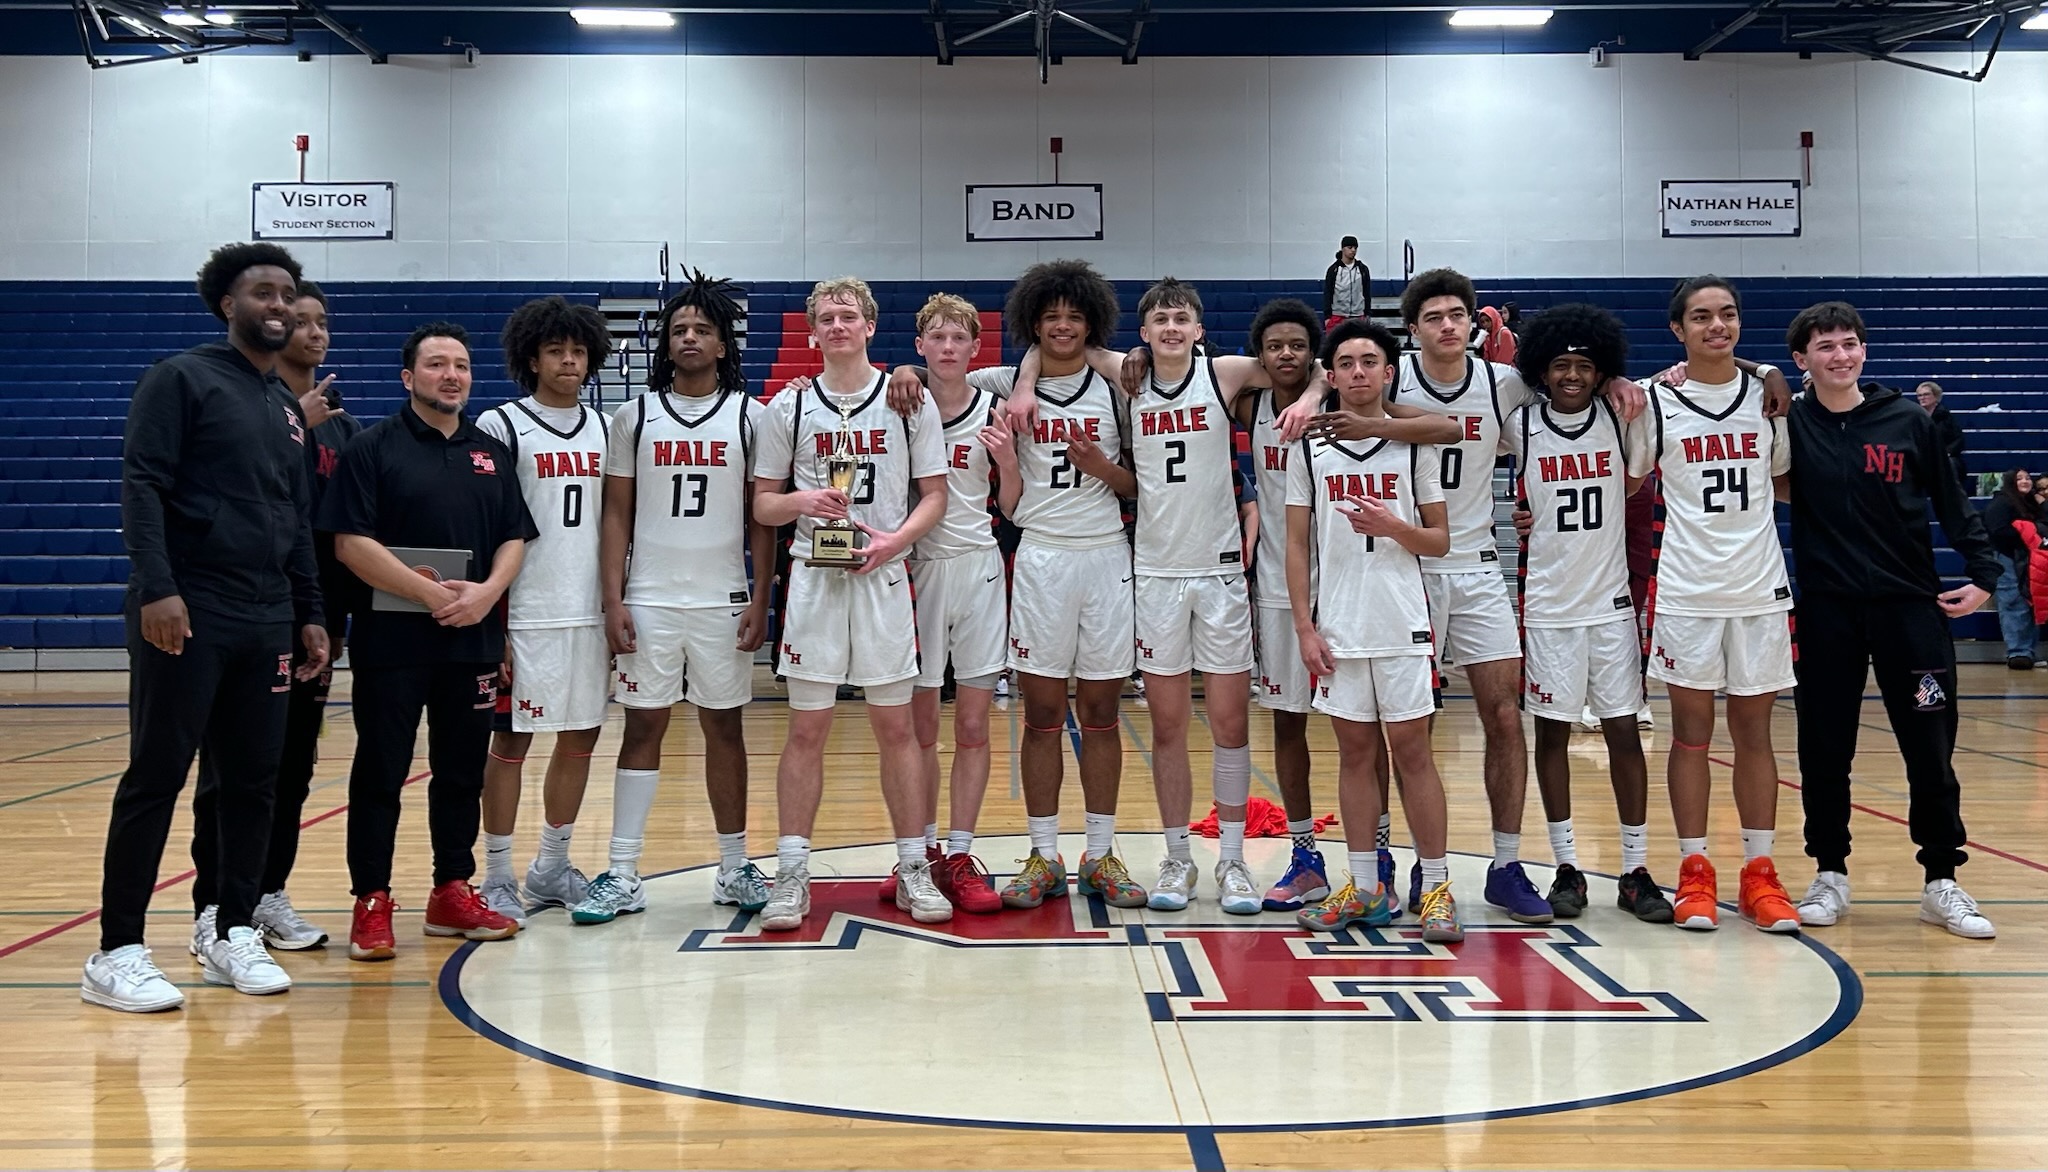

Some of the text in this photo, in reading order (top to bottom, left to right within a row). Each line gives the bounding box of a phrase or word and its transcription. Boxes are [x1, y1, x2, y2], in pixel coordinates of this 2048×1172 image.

[281, 191, 368, 208] VISITOR
[991, 200, 1075, 221] BAND
[1667, 196, 1796, 211] NATHAN HALE
[272, 218, 376, 230] STUDENT SECTION
[1689, 218, 1772, 228] STUDENT SECTION
[1033, 417, 1102, 444] HALE
[1140, 406, 1209, 436] HALE
[653, 441, 729, 467] HALE
[814, 429, 888, 457] HALE
[1680, 432, 1760, 464] HALE
[534, 452, 601, 479] HALE
[1165, 440, 1187, 484] 2
[1440, 447, 1463, 490] 0
[1538, 450, 1612, 483] HALE
[1862, 443, 1905, 484] NH
[670, 473, 709, 518] 13
[853, 462, 876, 505] 3
[1324, 473, 1400, 502] HALE
[1702, 467, 1749, 513] 24
[562, 484, 584, 528] 0
[1556, 486, 1603, 533] 20
[784, 643, 803, 666] NH
[1010, 637, 1030, 659] NH
[1136, 638, 1154, 659] NH
[1656, 646, 1676, 669] NH
[619, 671, 638, 693] NH
[1262, 675, 1282, 695] NH
[1530, 683, 1554, 704] NH
[518, 699, 545, 718] NH
